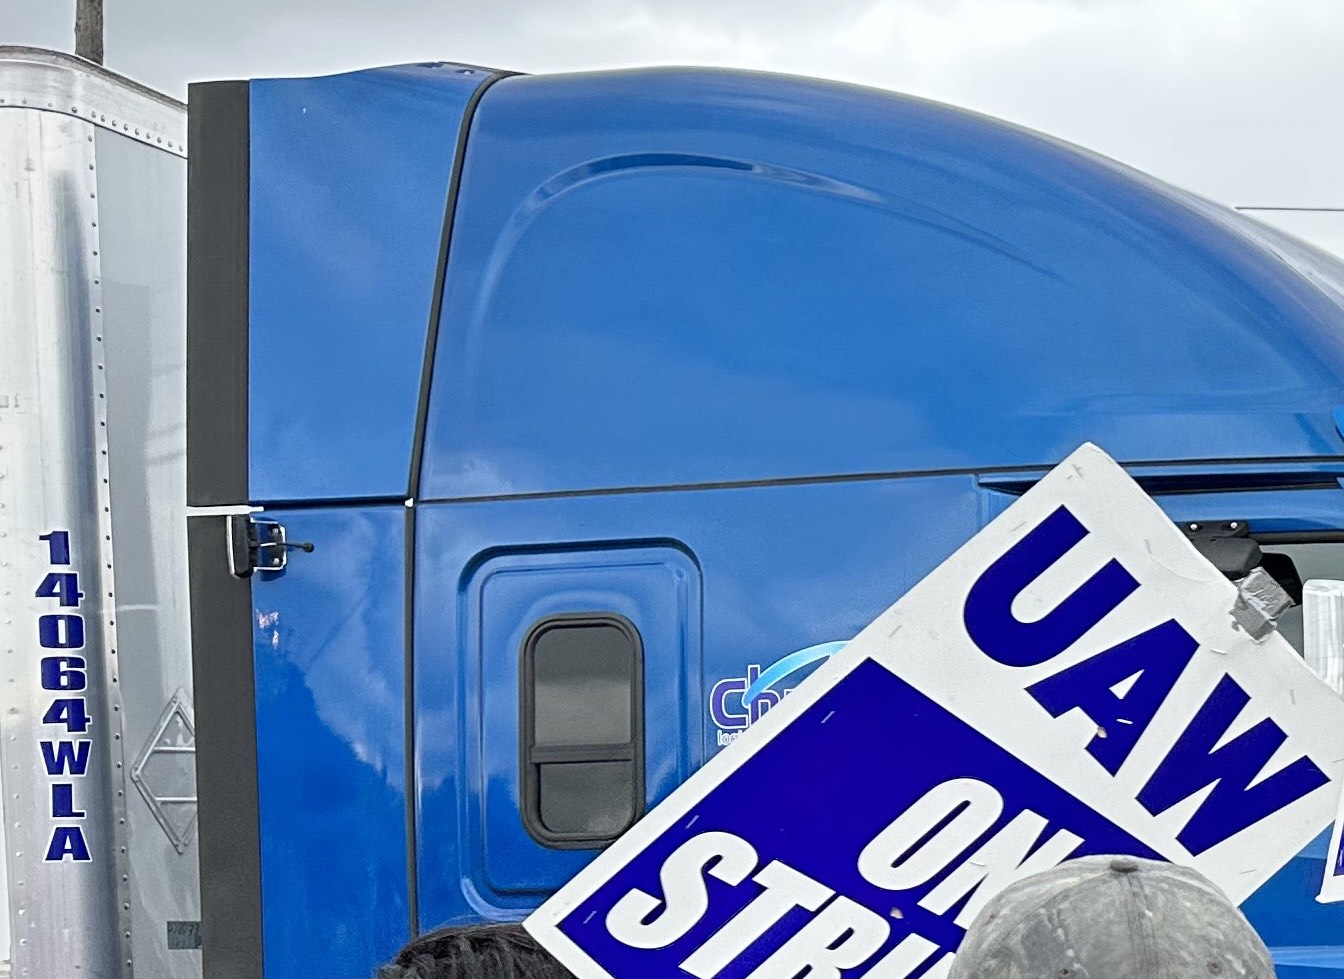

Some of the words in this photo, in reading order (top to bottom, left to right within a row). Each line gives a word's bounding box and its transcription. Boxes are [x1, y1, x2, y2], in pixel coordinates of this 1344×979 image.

[33, 529, 93, 864] 14064WLA
[962, 504, 1333, 857] UAW
[857, 777, 1086, 930] ON
